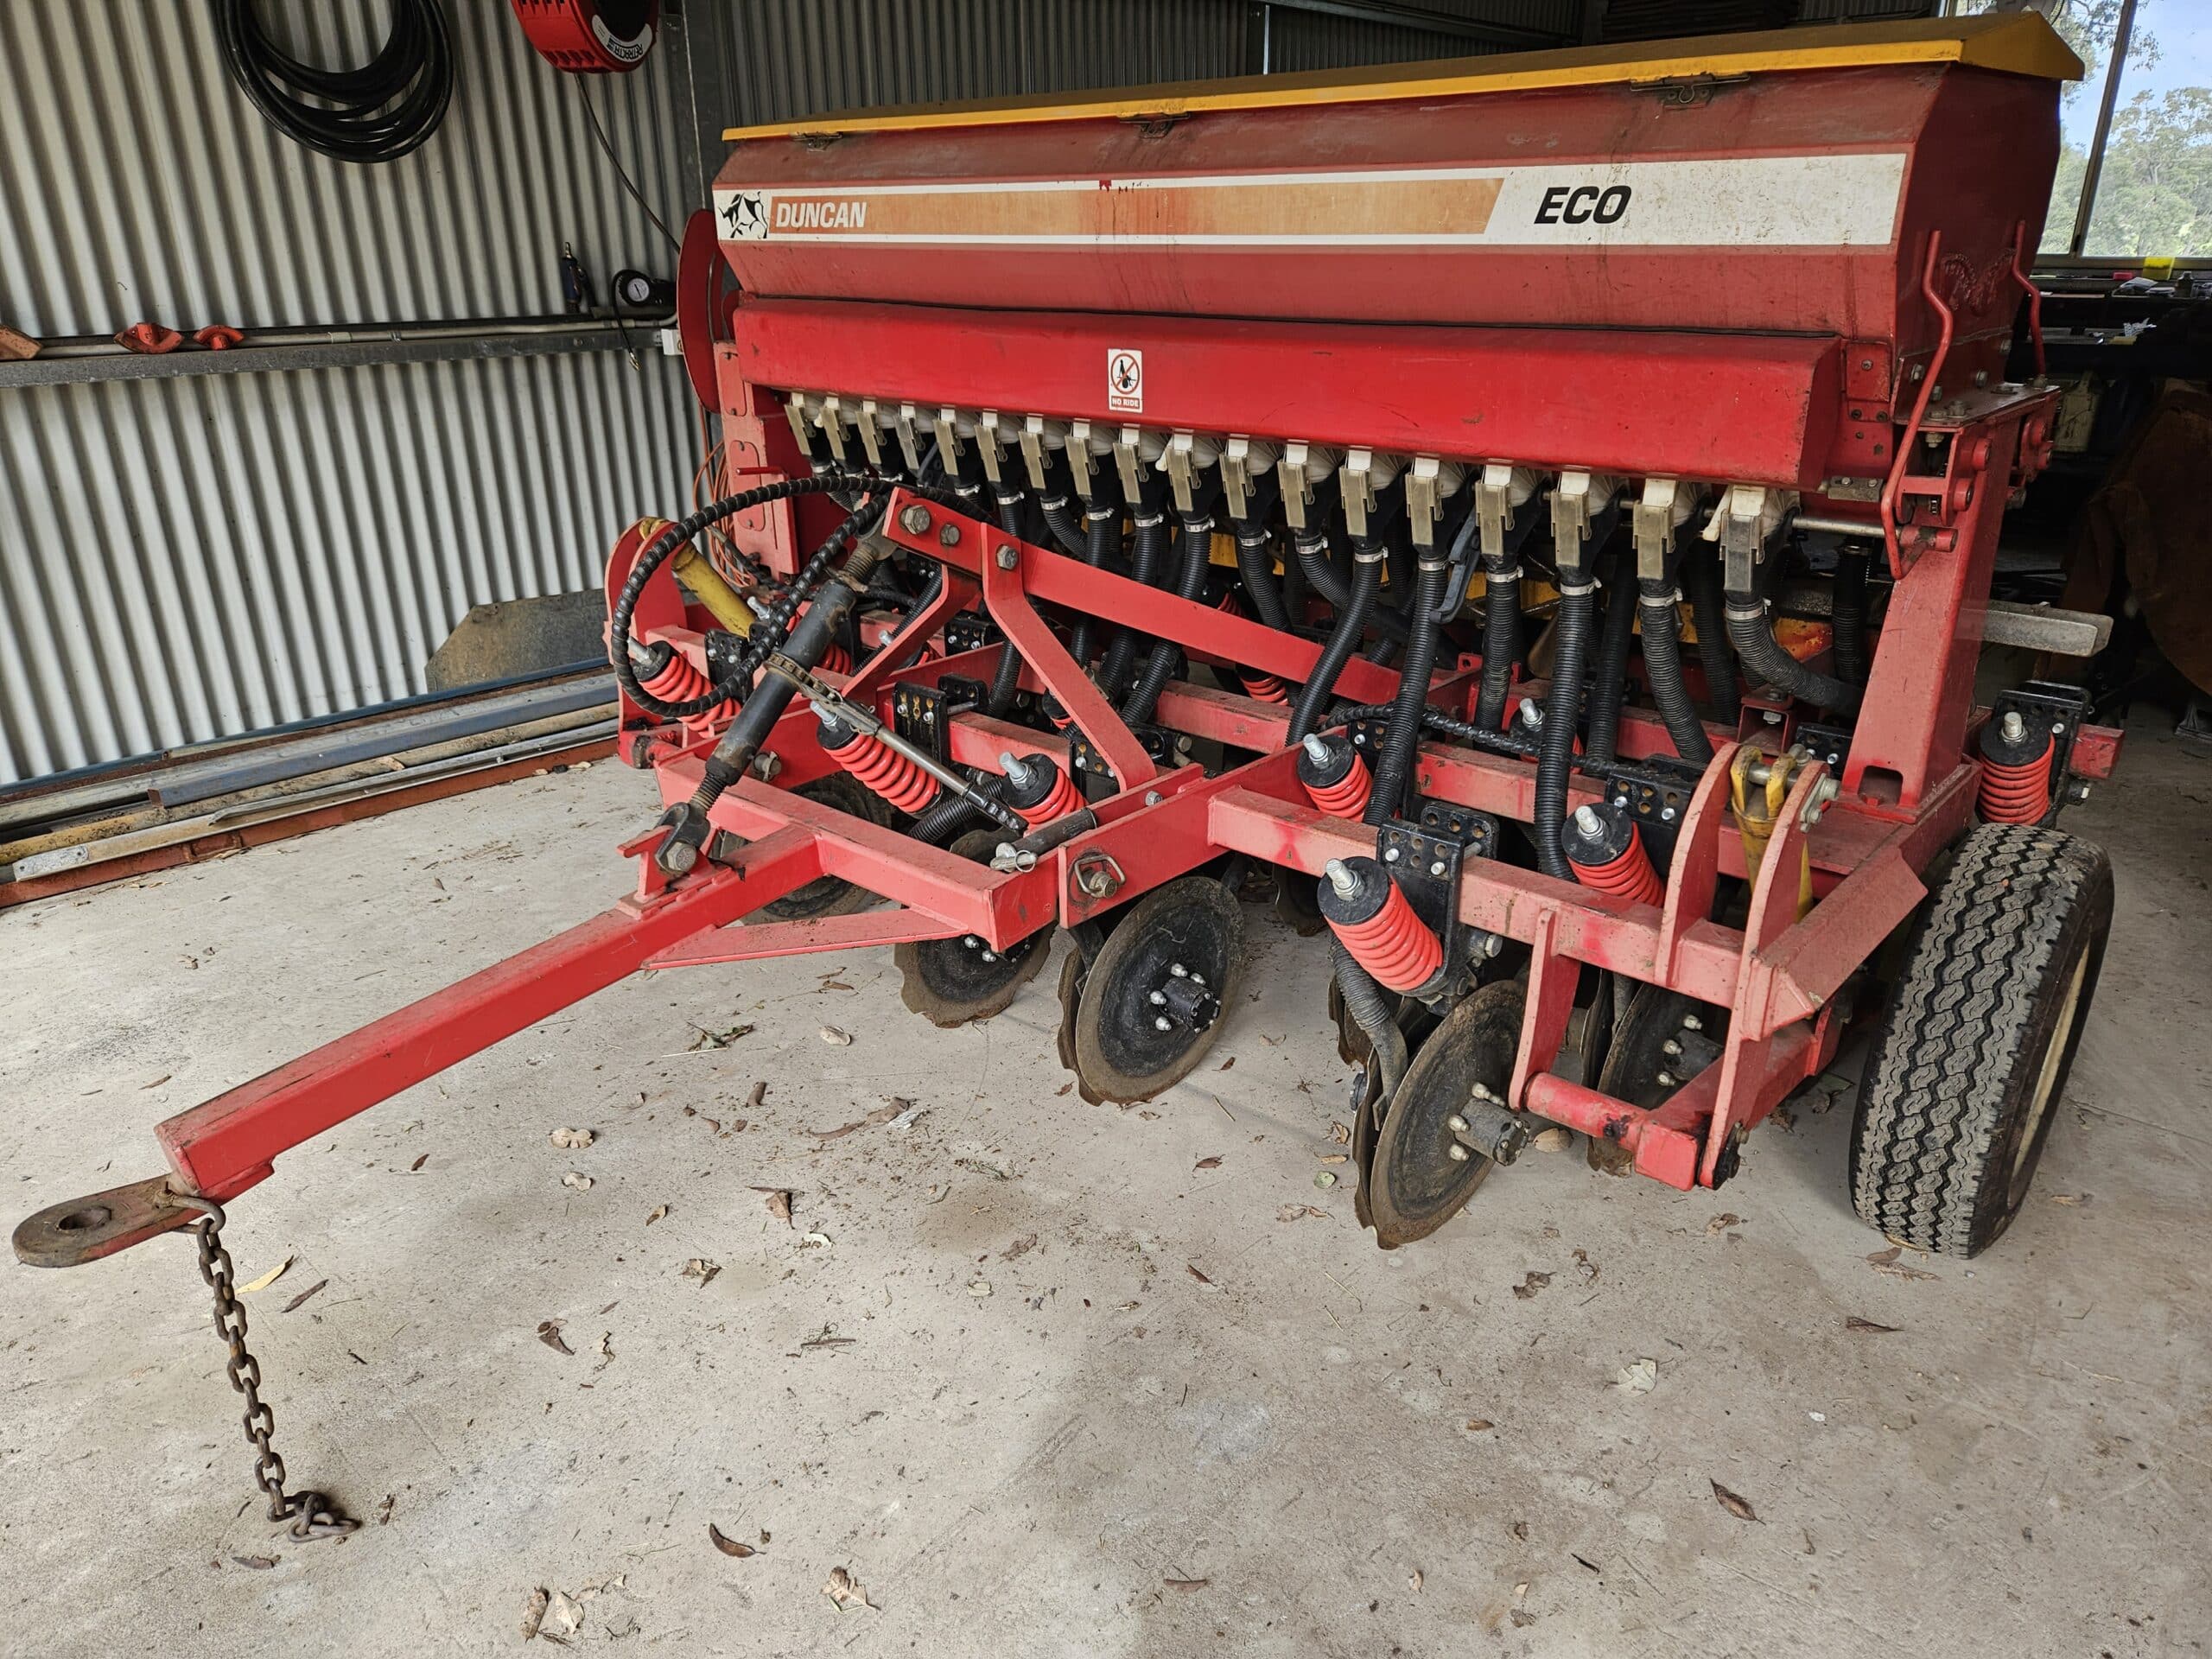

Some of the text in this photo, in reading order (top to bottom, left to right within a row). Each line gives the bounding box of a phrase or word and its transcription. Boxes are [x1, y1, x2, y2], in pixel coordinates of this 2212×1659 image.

[775, 201, 867, 228] DUNCAN
[1534, 185, 1632, 225] ECO
[1112, 397, 1139, 408] NO RIDE
